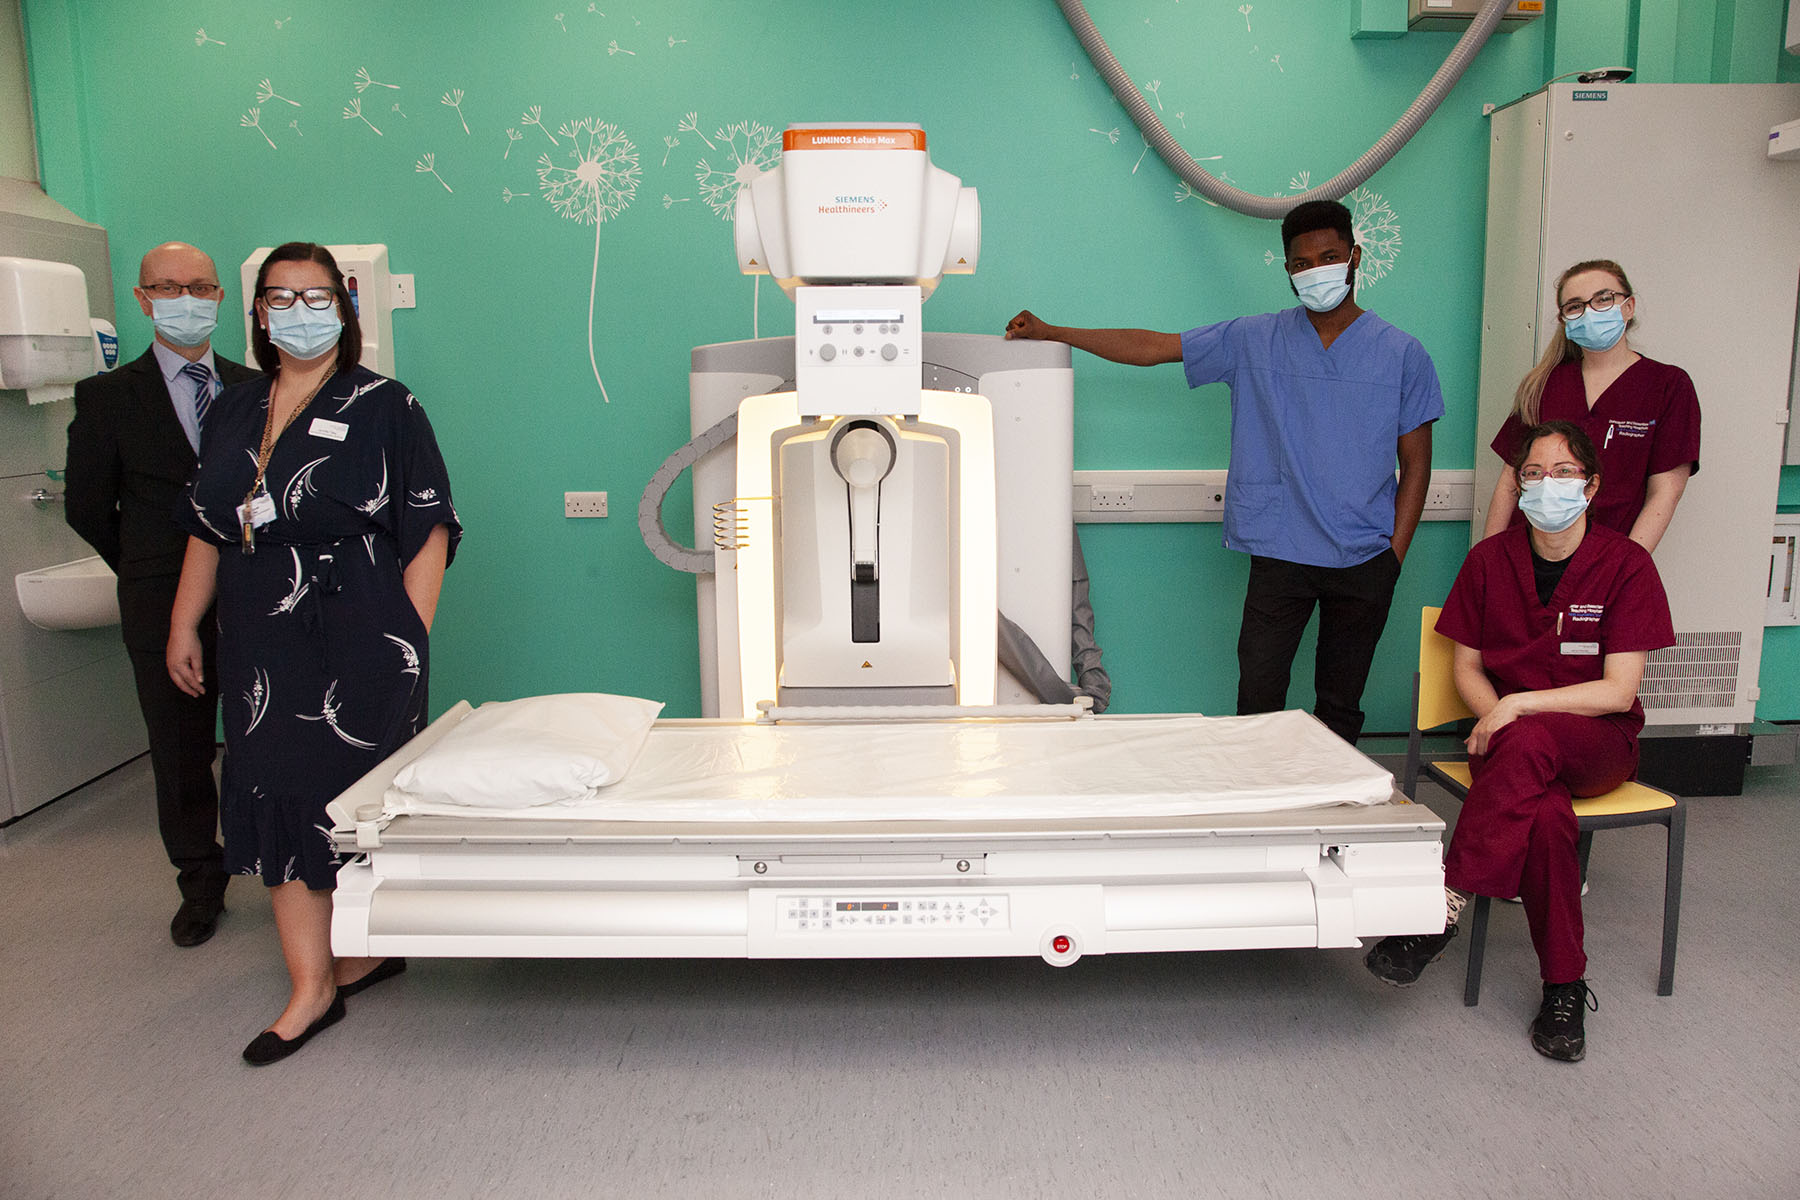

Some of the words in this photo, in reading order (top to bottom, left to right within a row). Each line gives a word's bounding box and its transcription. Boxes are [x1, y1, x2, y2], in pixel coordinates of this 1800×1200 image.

[811, 135, 851, 145] LUMINOS
[852, 135, 877, 145] Lotus
[877, 136, 896, 145] Max
[834, 195, 875, 203] SIEMENS
[818, 204, 875, 214] Healthineers
